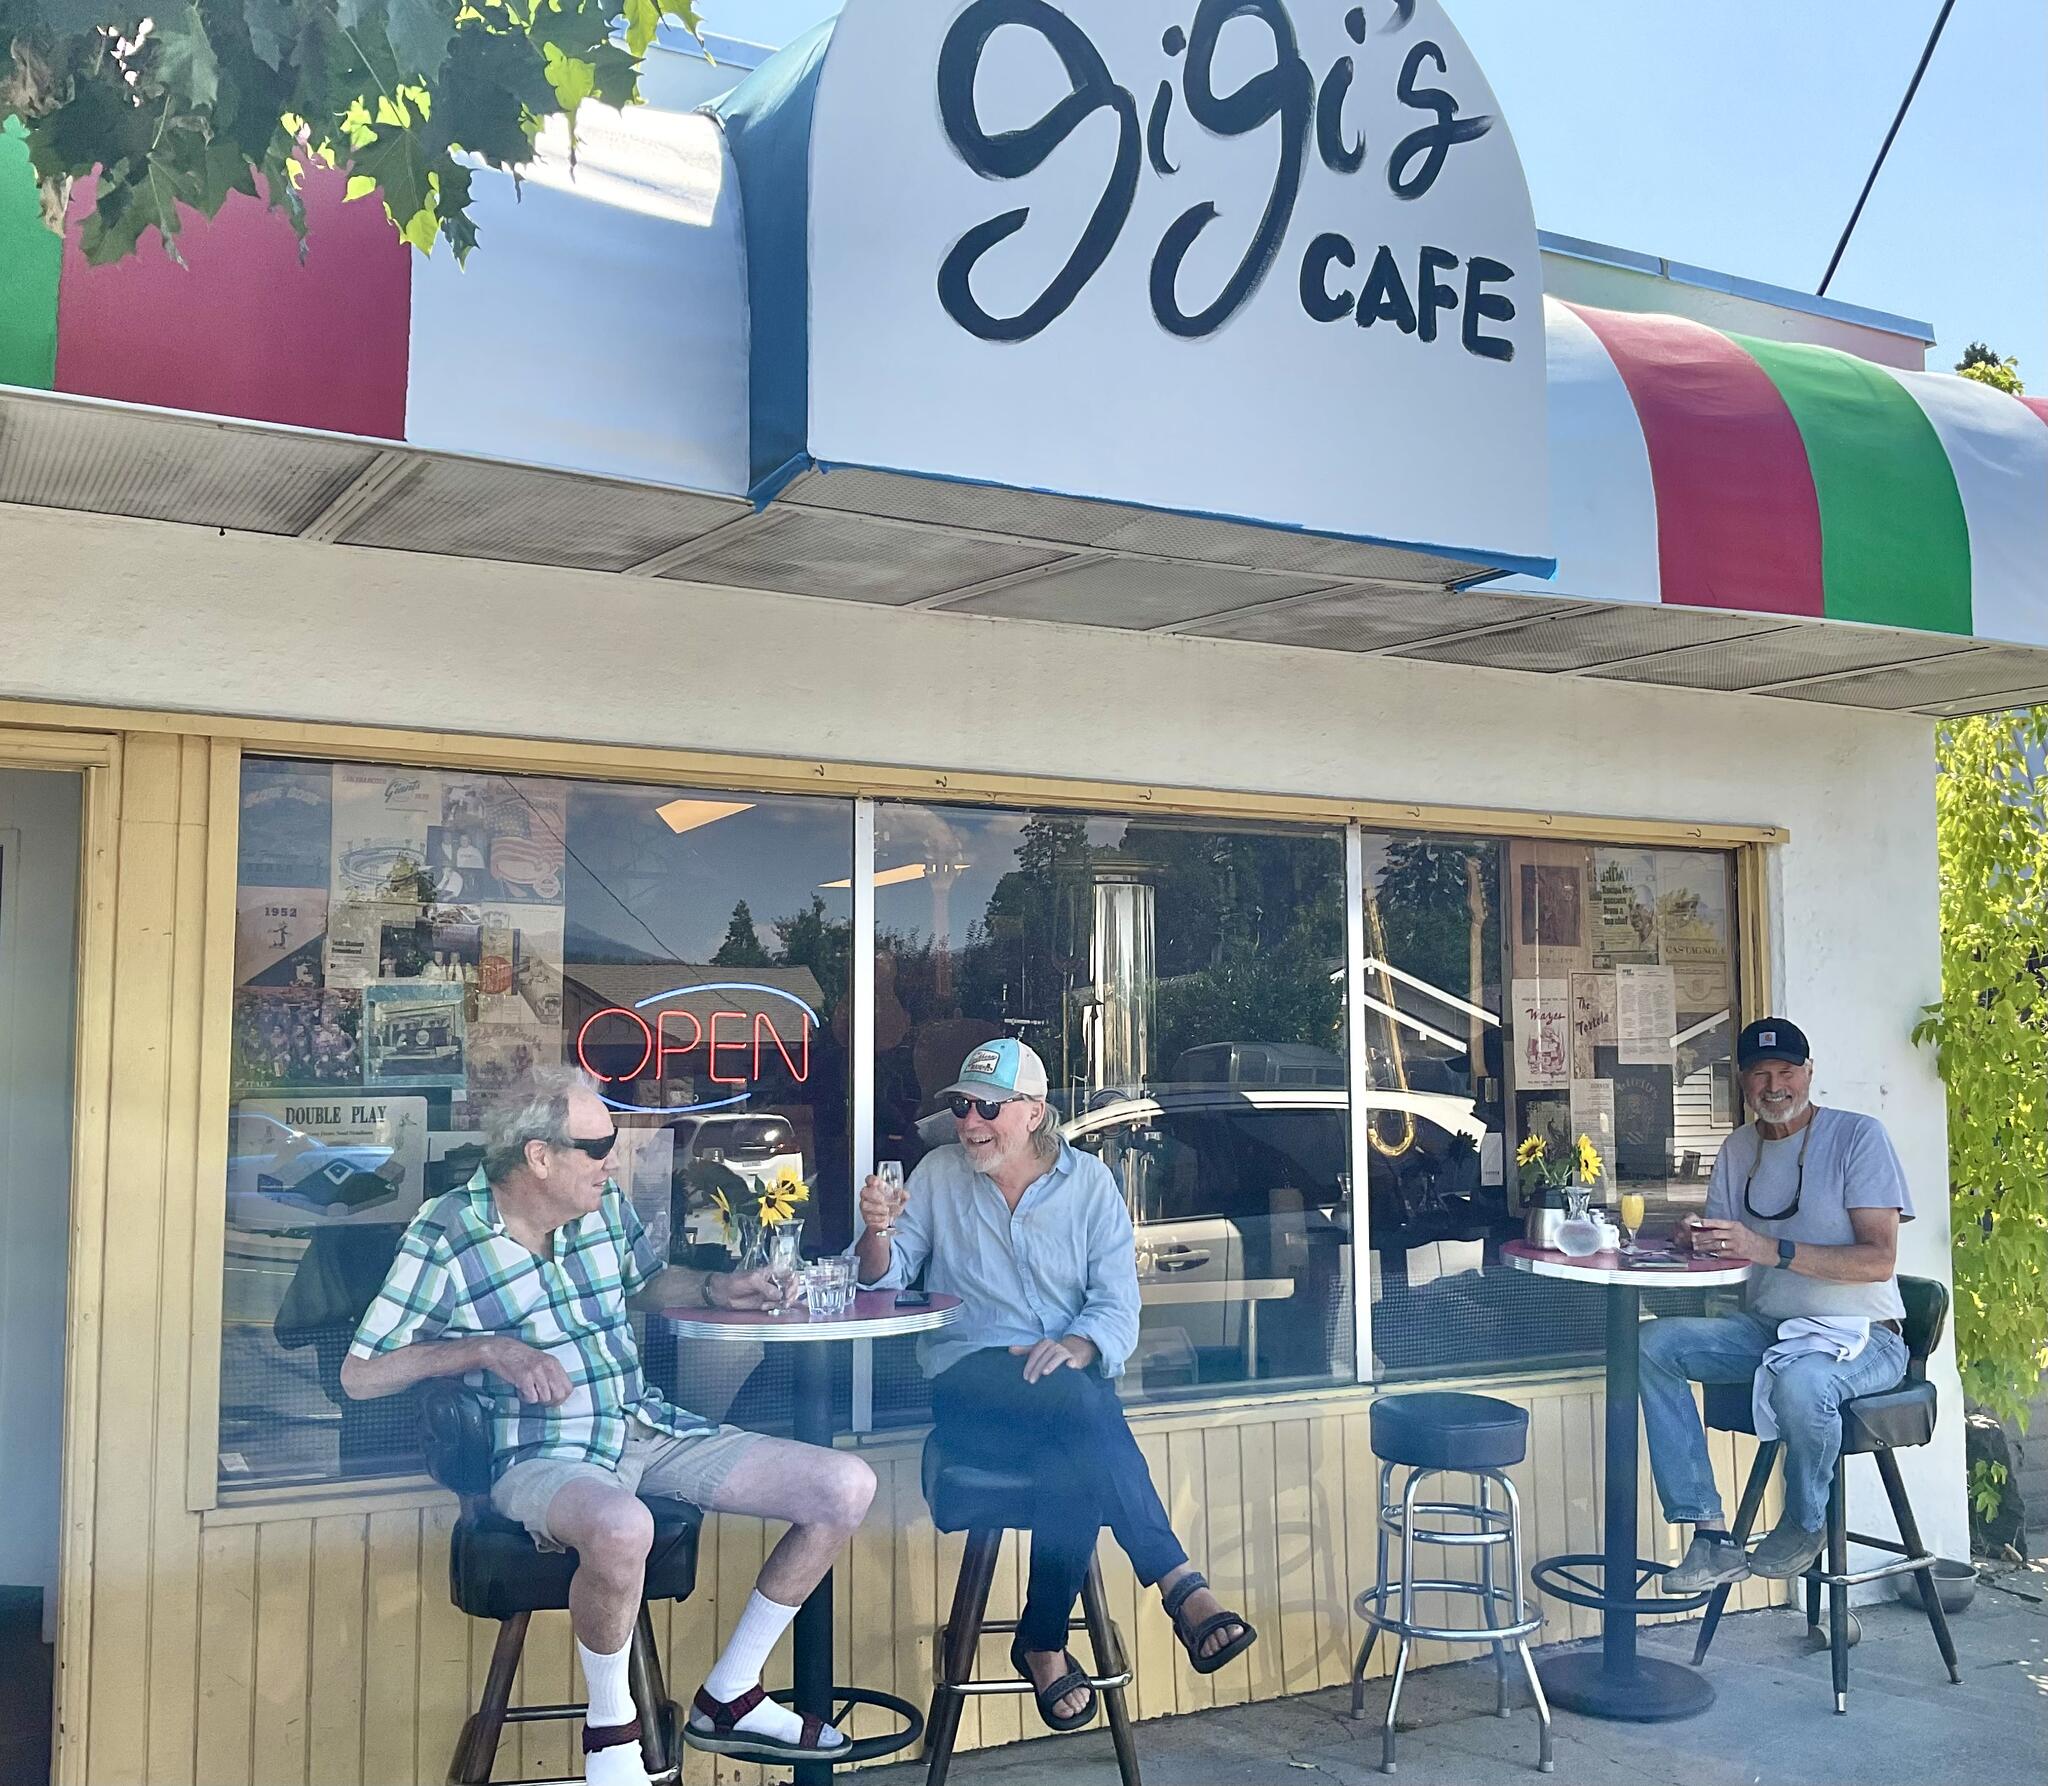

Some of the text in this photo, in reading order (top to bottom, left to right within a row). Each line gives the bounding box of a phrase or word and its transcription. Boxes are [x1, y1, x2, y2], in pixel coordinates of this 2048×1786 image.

[1299, 232, 1516, 362] CAFE
[264, 906, 298, 918] 1952
[1575, 996, 1591, 1011] The
[577, 1007, 809, 1083] OPEN
[285, 1104, 388, 1125] DOUBLE PLAY
